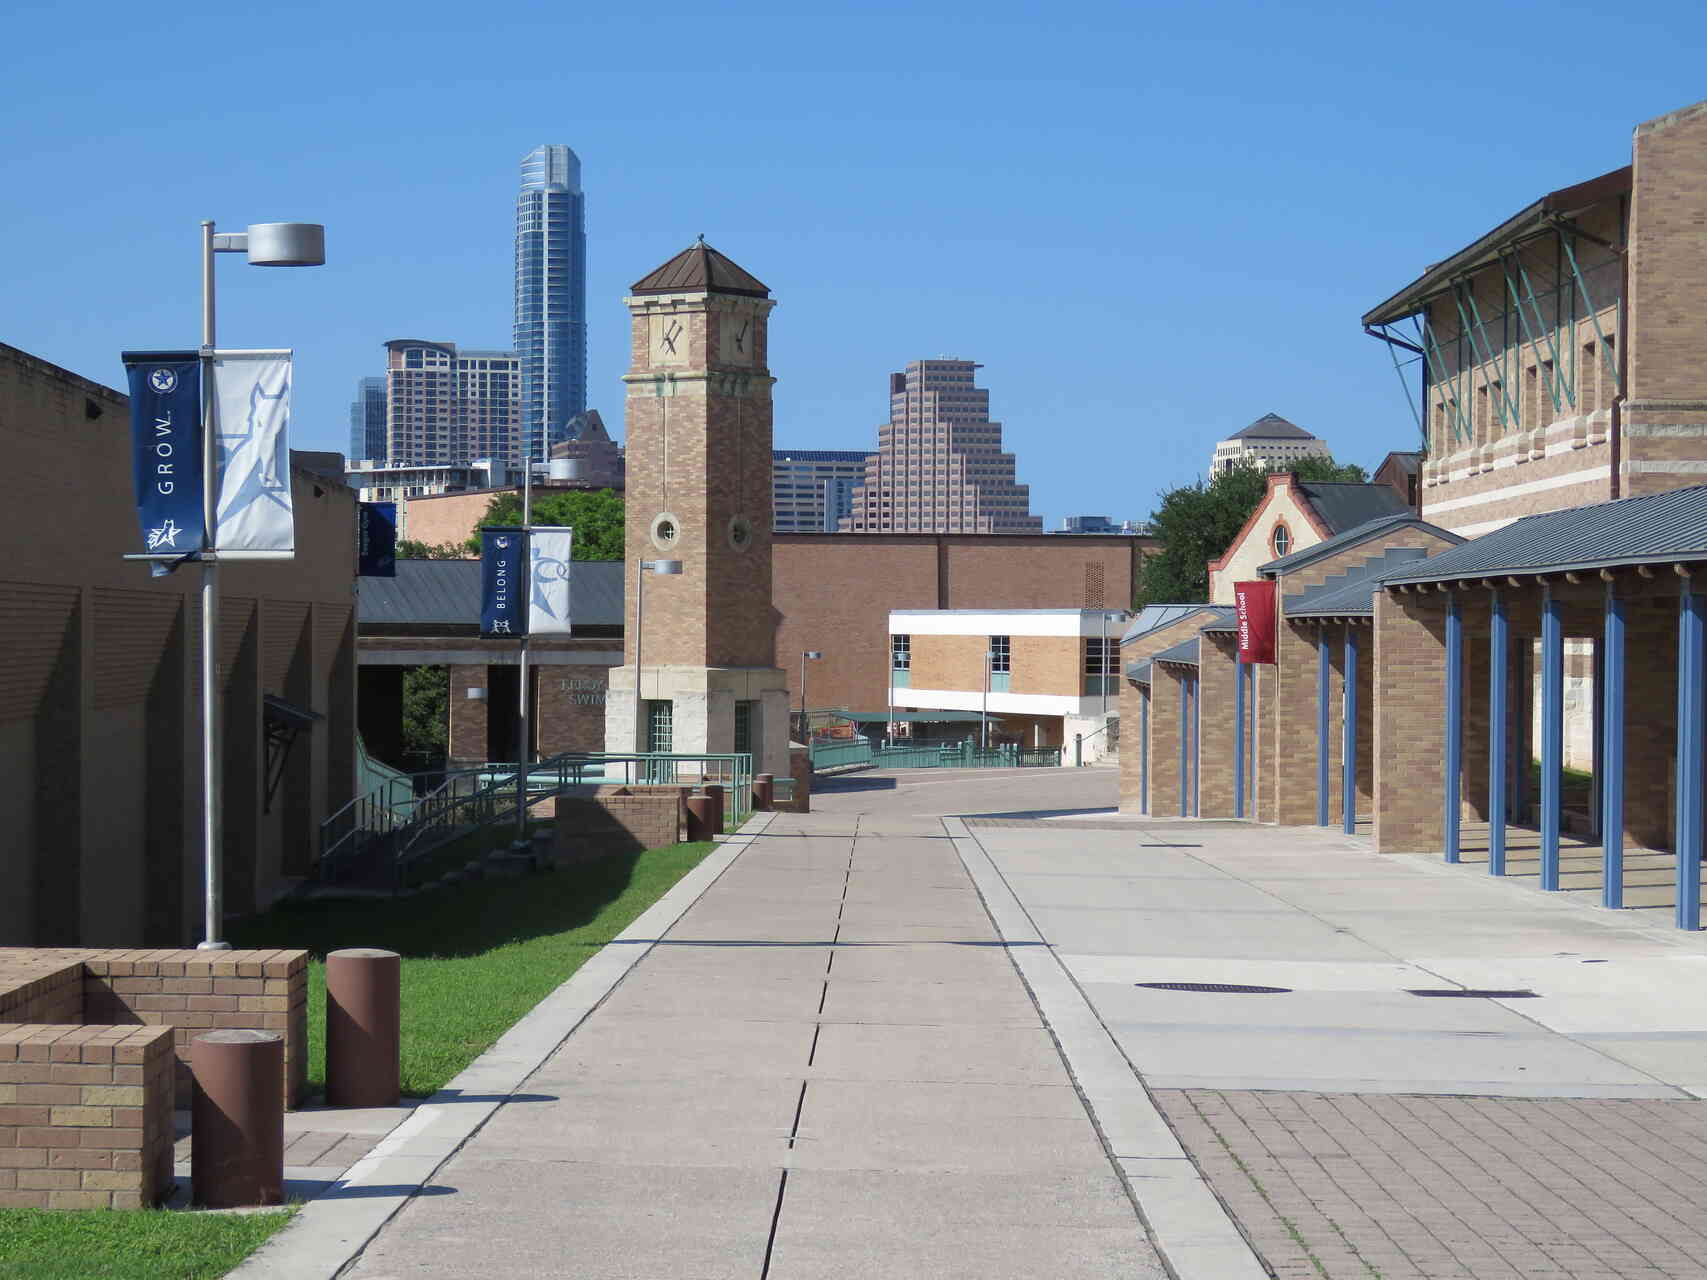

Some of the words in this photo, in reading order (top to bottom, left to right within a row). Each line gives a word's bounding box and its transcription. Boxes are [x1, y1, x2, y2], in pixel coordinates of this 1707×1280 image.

[496, 560, 506, 609] BELONG
[1237, 592, 1247, 620] School
[1239, 621, 1249, 650] Middle
